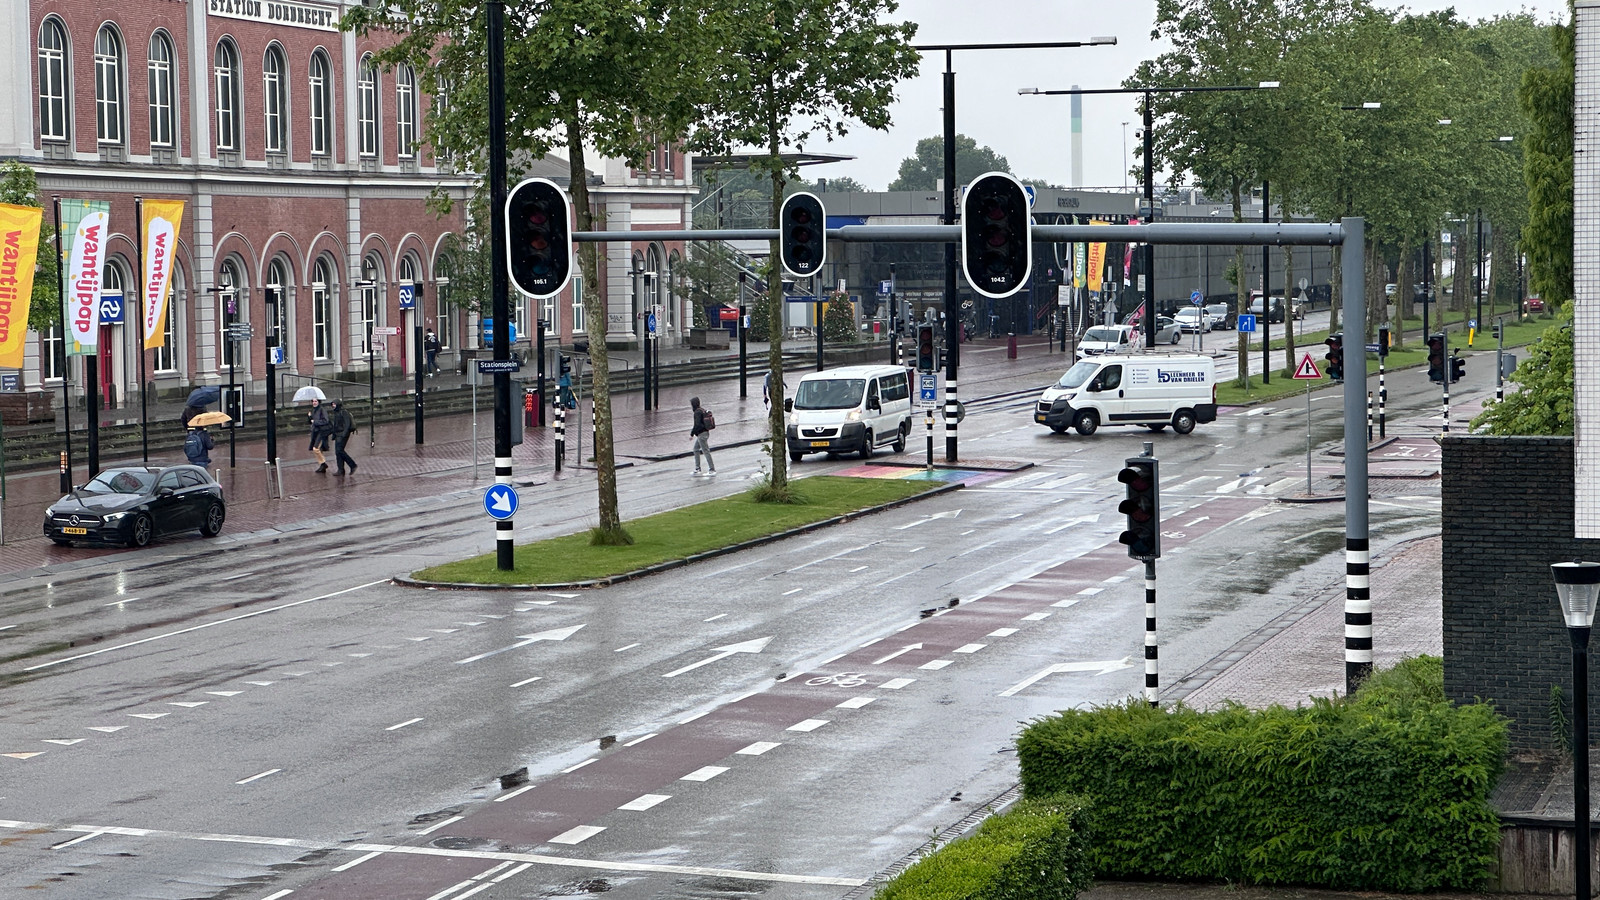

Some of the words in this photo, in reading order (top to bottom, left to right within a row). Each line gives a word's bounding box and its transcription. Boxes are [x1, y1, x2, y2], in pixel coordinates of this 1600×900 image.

[211, 0, 261, 17] STATION
[268, 3, 332, 26] DORDRECHT
[75, 225, 101, 333] wantijpop
[146, 232, 167, 329] wantijpop
[480, 361, 518, 369] Stationsplein
